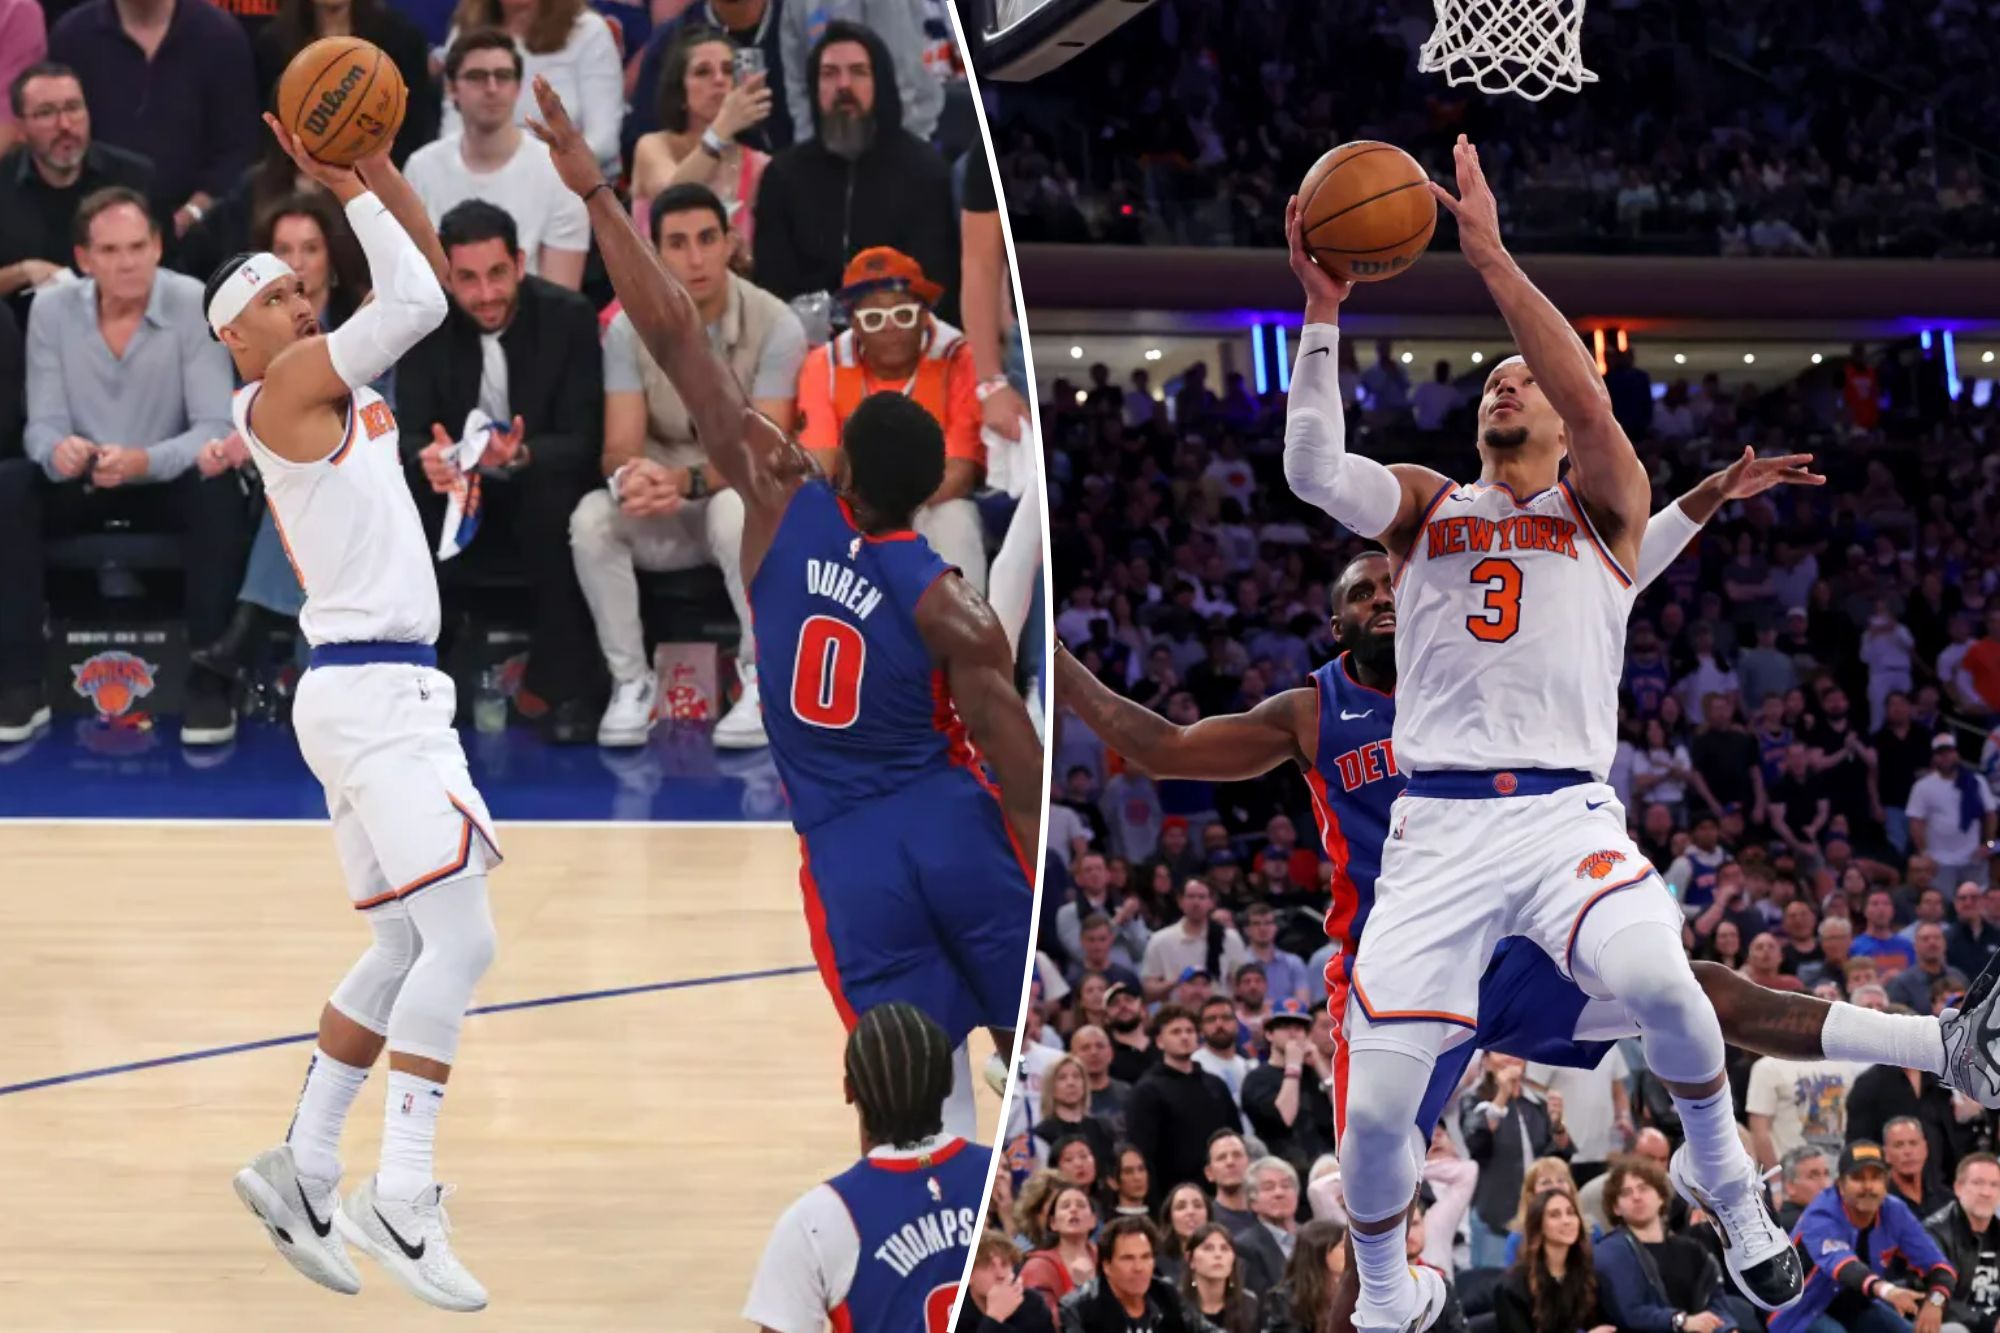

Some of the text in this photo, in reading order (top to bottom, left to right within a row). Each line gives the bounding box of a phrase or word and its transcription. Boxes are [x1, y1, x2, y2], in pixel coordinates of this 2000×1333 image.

[304, 63, 366, 136] Wilson
[807, 558, 884, 622] DUREN
[1466, 557, 1523, 643] 3
[790, 615, 866, 729] 0
[874, 1207, 976, 1278] THOMPS
